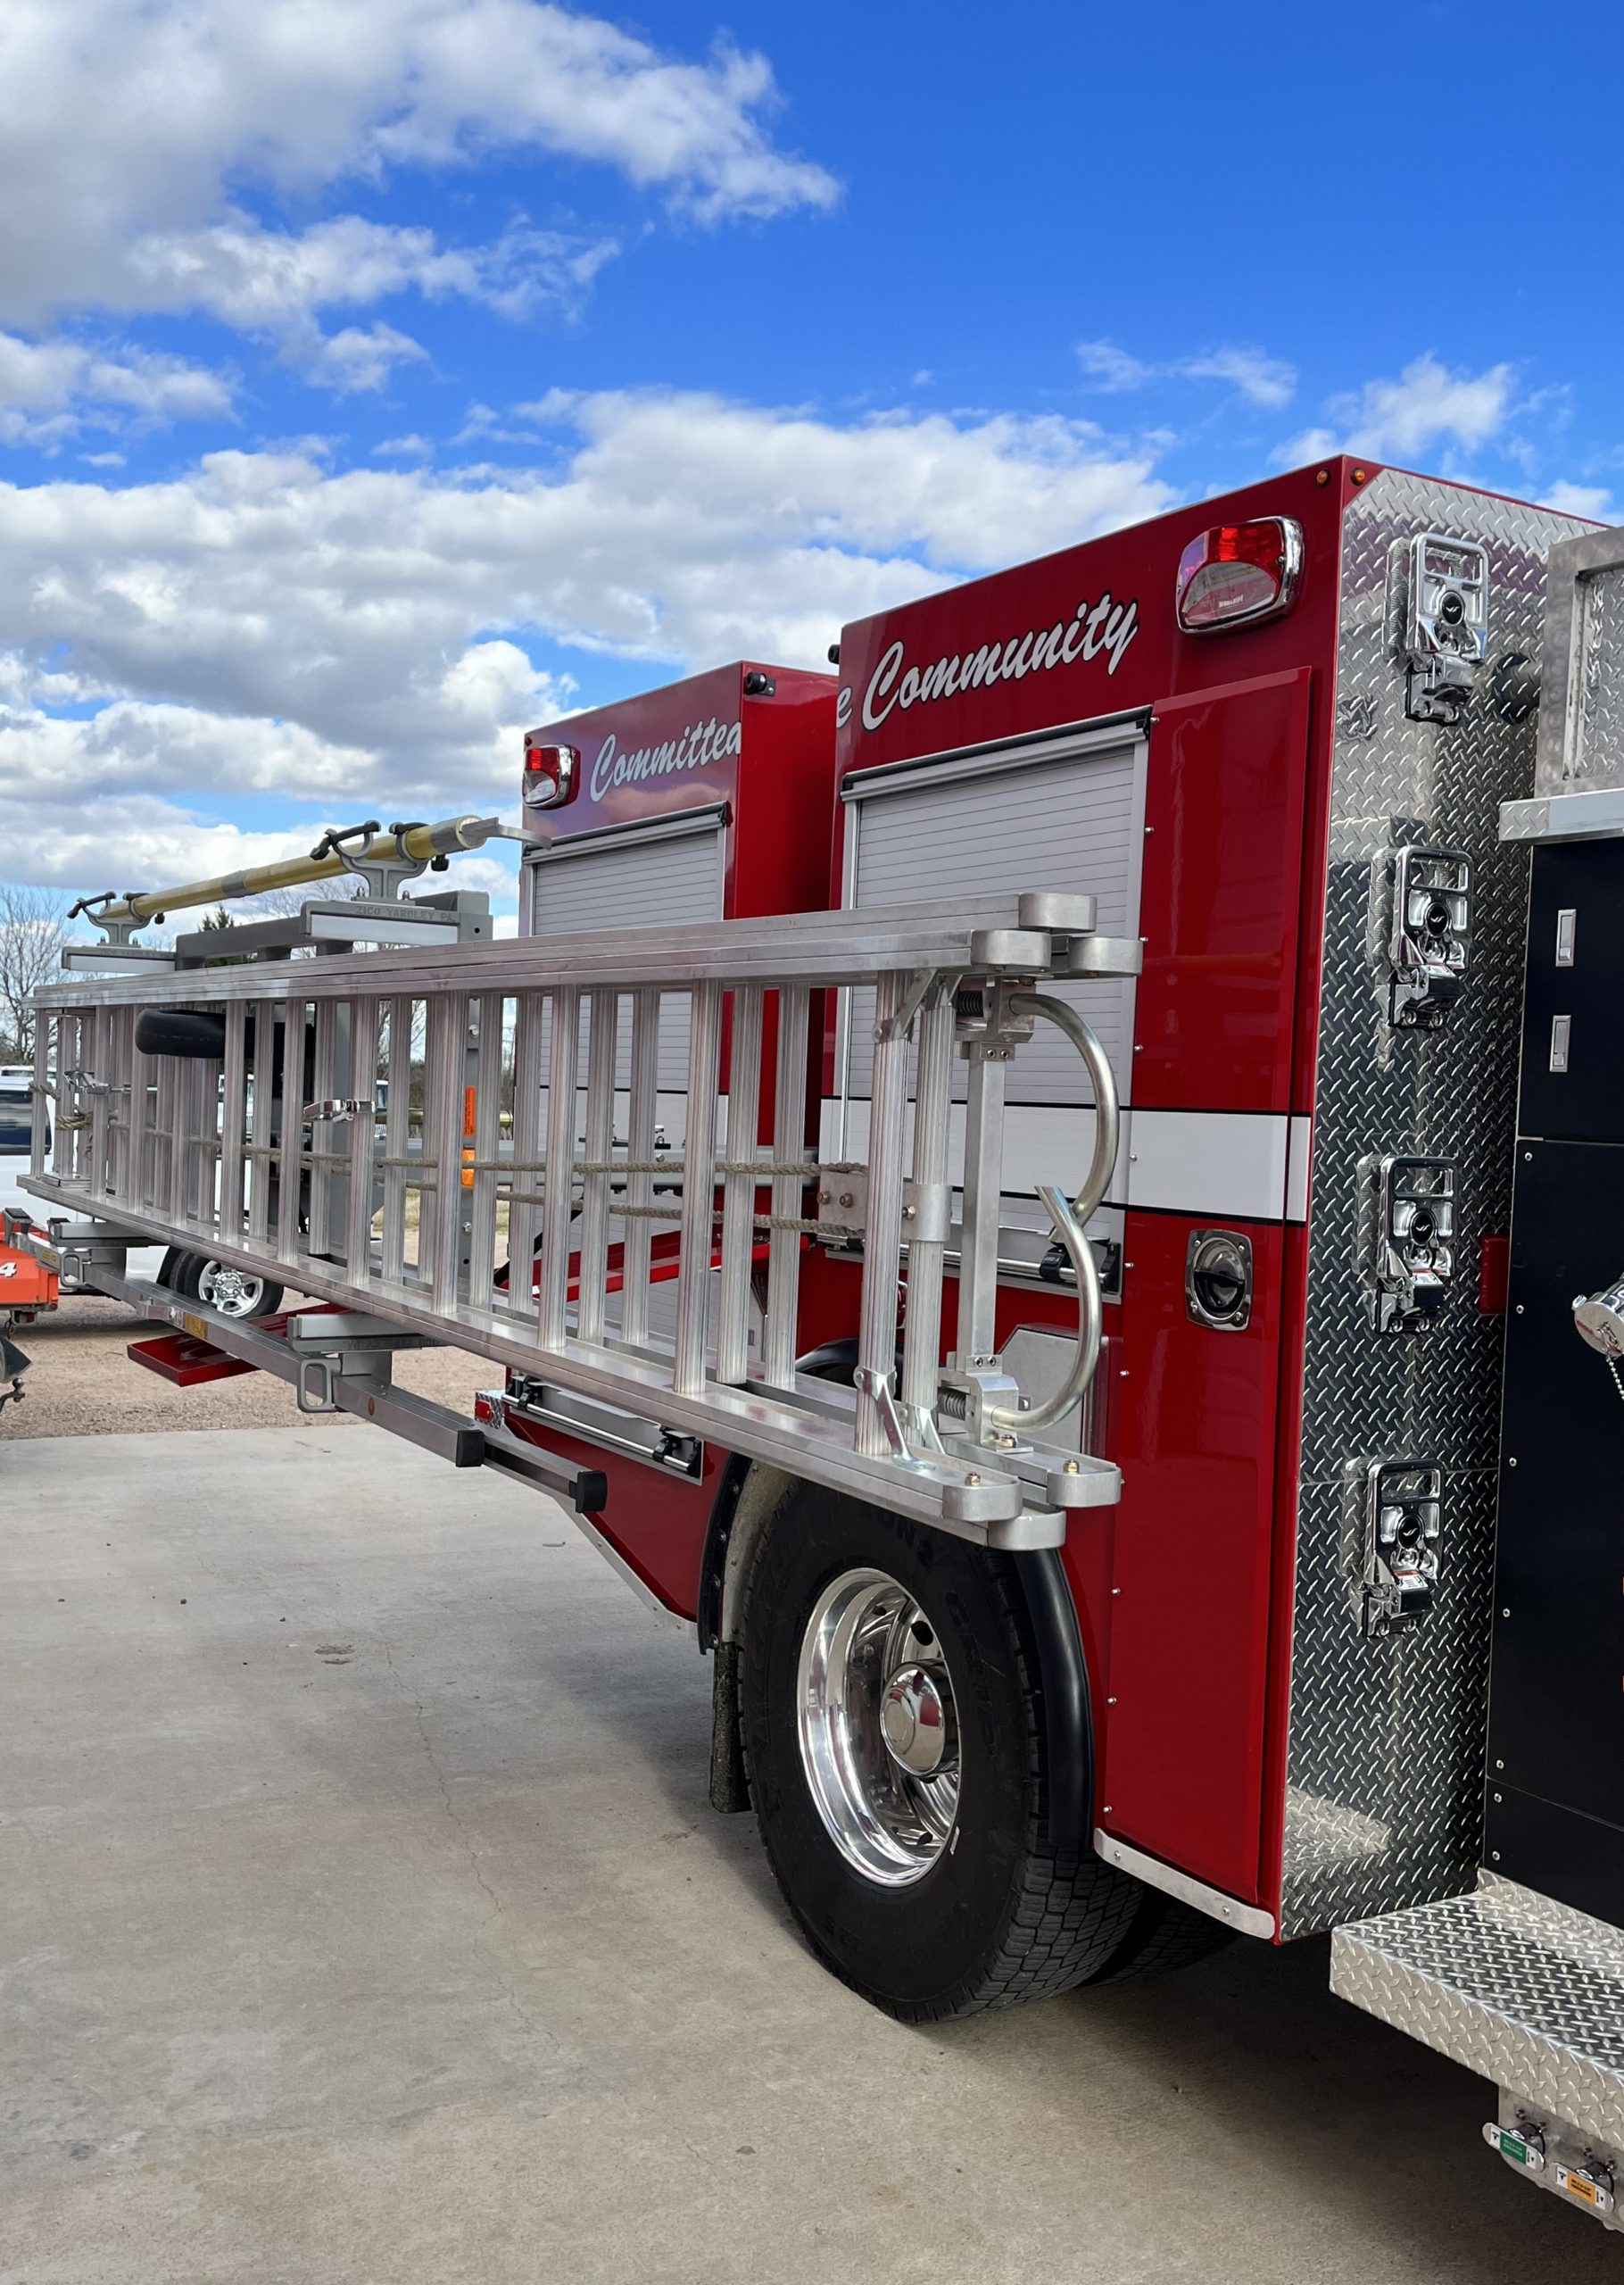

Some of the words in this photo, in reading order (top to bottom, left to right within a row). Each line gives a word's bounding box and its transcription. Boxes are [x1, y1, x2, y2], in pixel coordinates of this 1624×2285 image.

[861, 591, 1139, 731] Community
[356, 905, 381, 917] ZICO
[387, 907, 435, 920] YARDLEY
